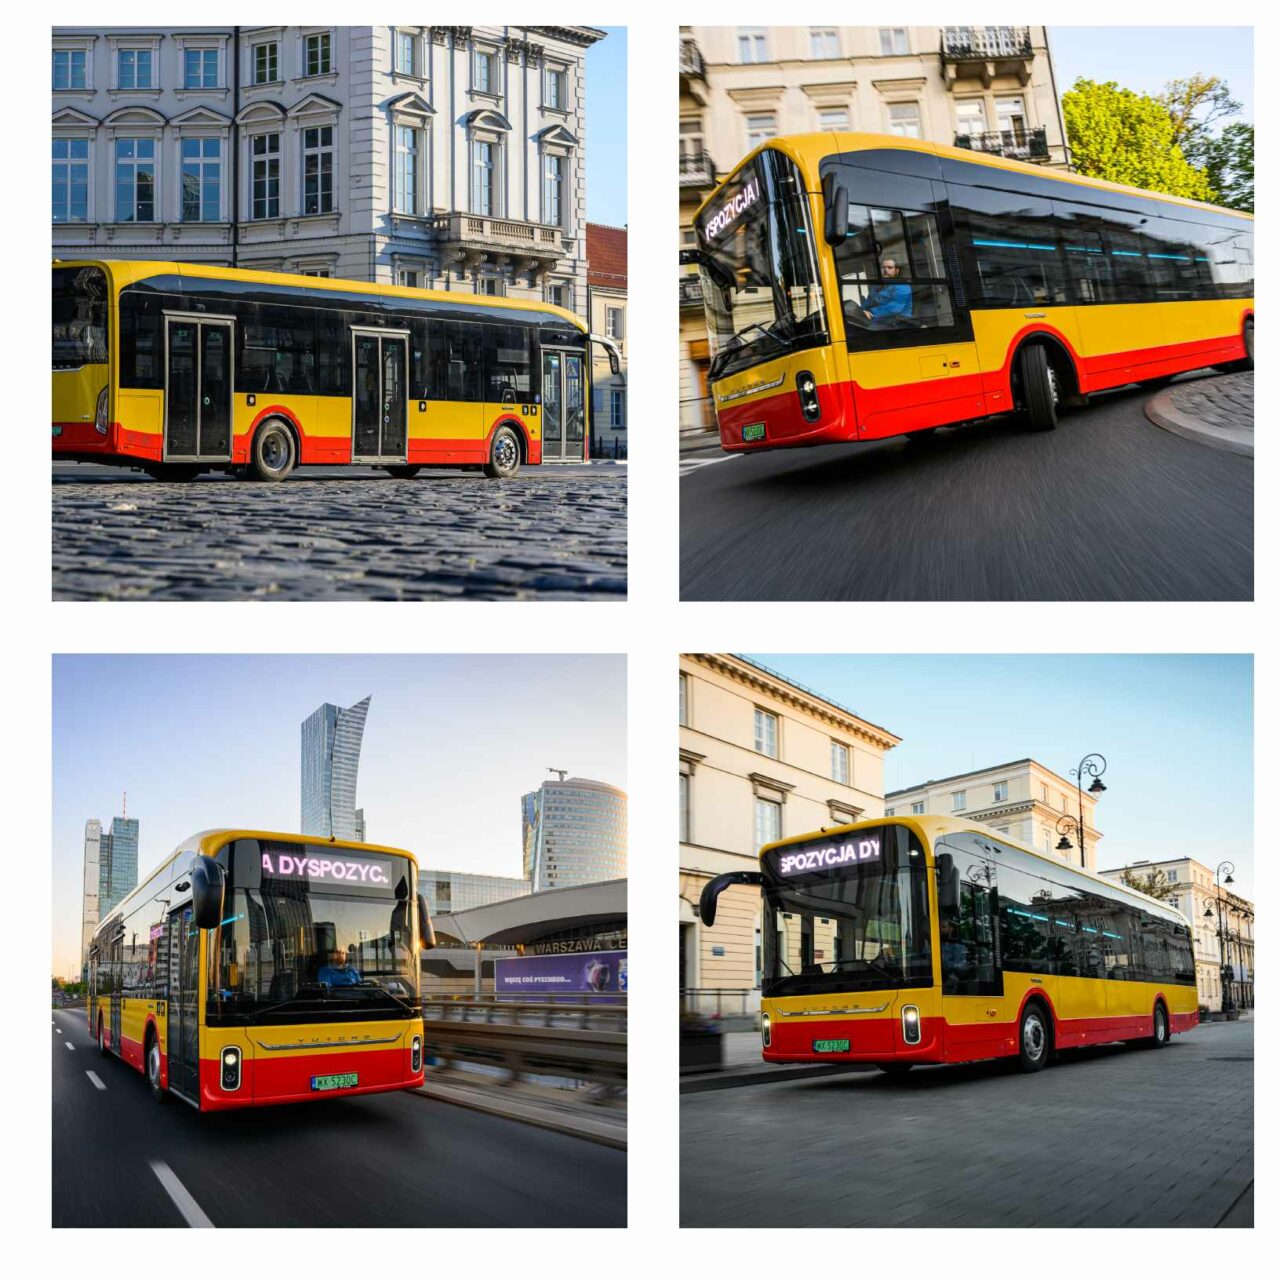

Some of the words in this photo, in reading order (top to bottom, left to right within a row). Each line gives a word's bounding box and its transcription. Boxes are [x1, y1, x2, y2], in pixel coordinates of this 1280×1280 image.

[279, 855, 388, 884] DYSPOZYC
[536, 939, 601, 954] WARSZAWA
[317, 1076, 329, 1087] WX
[331, 1075, 357, 1086] 5230C
